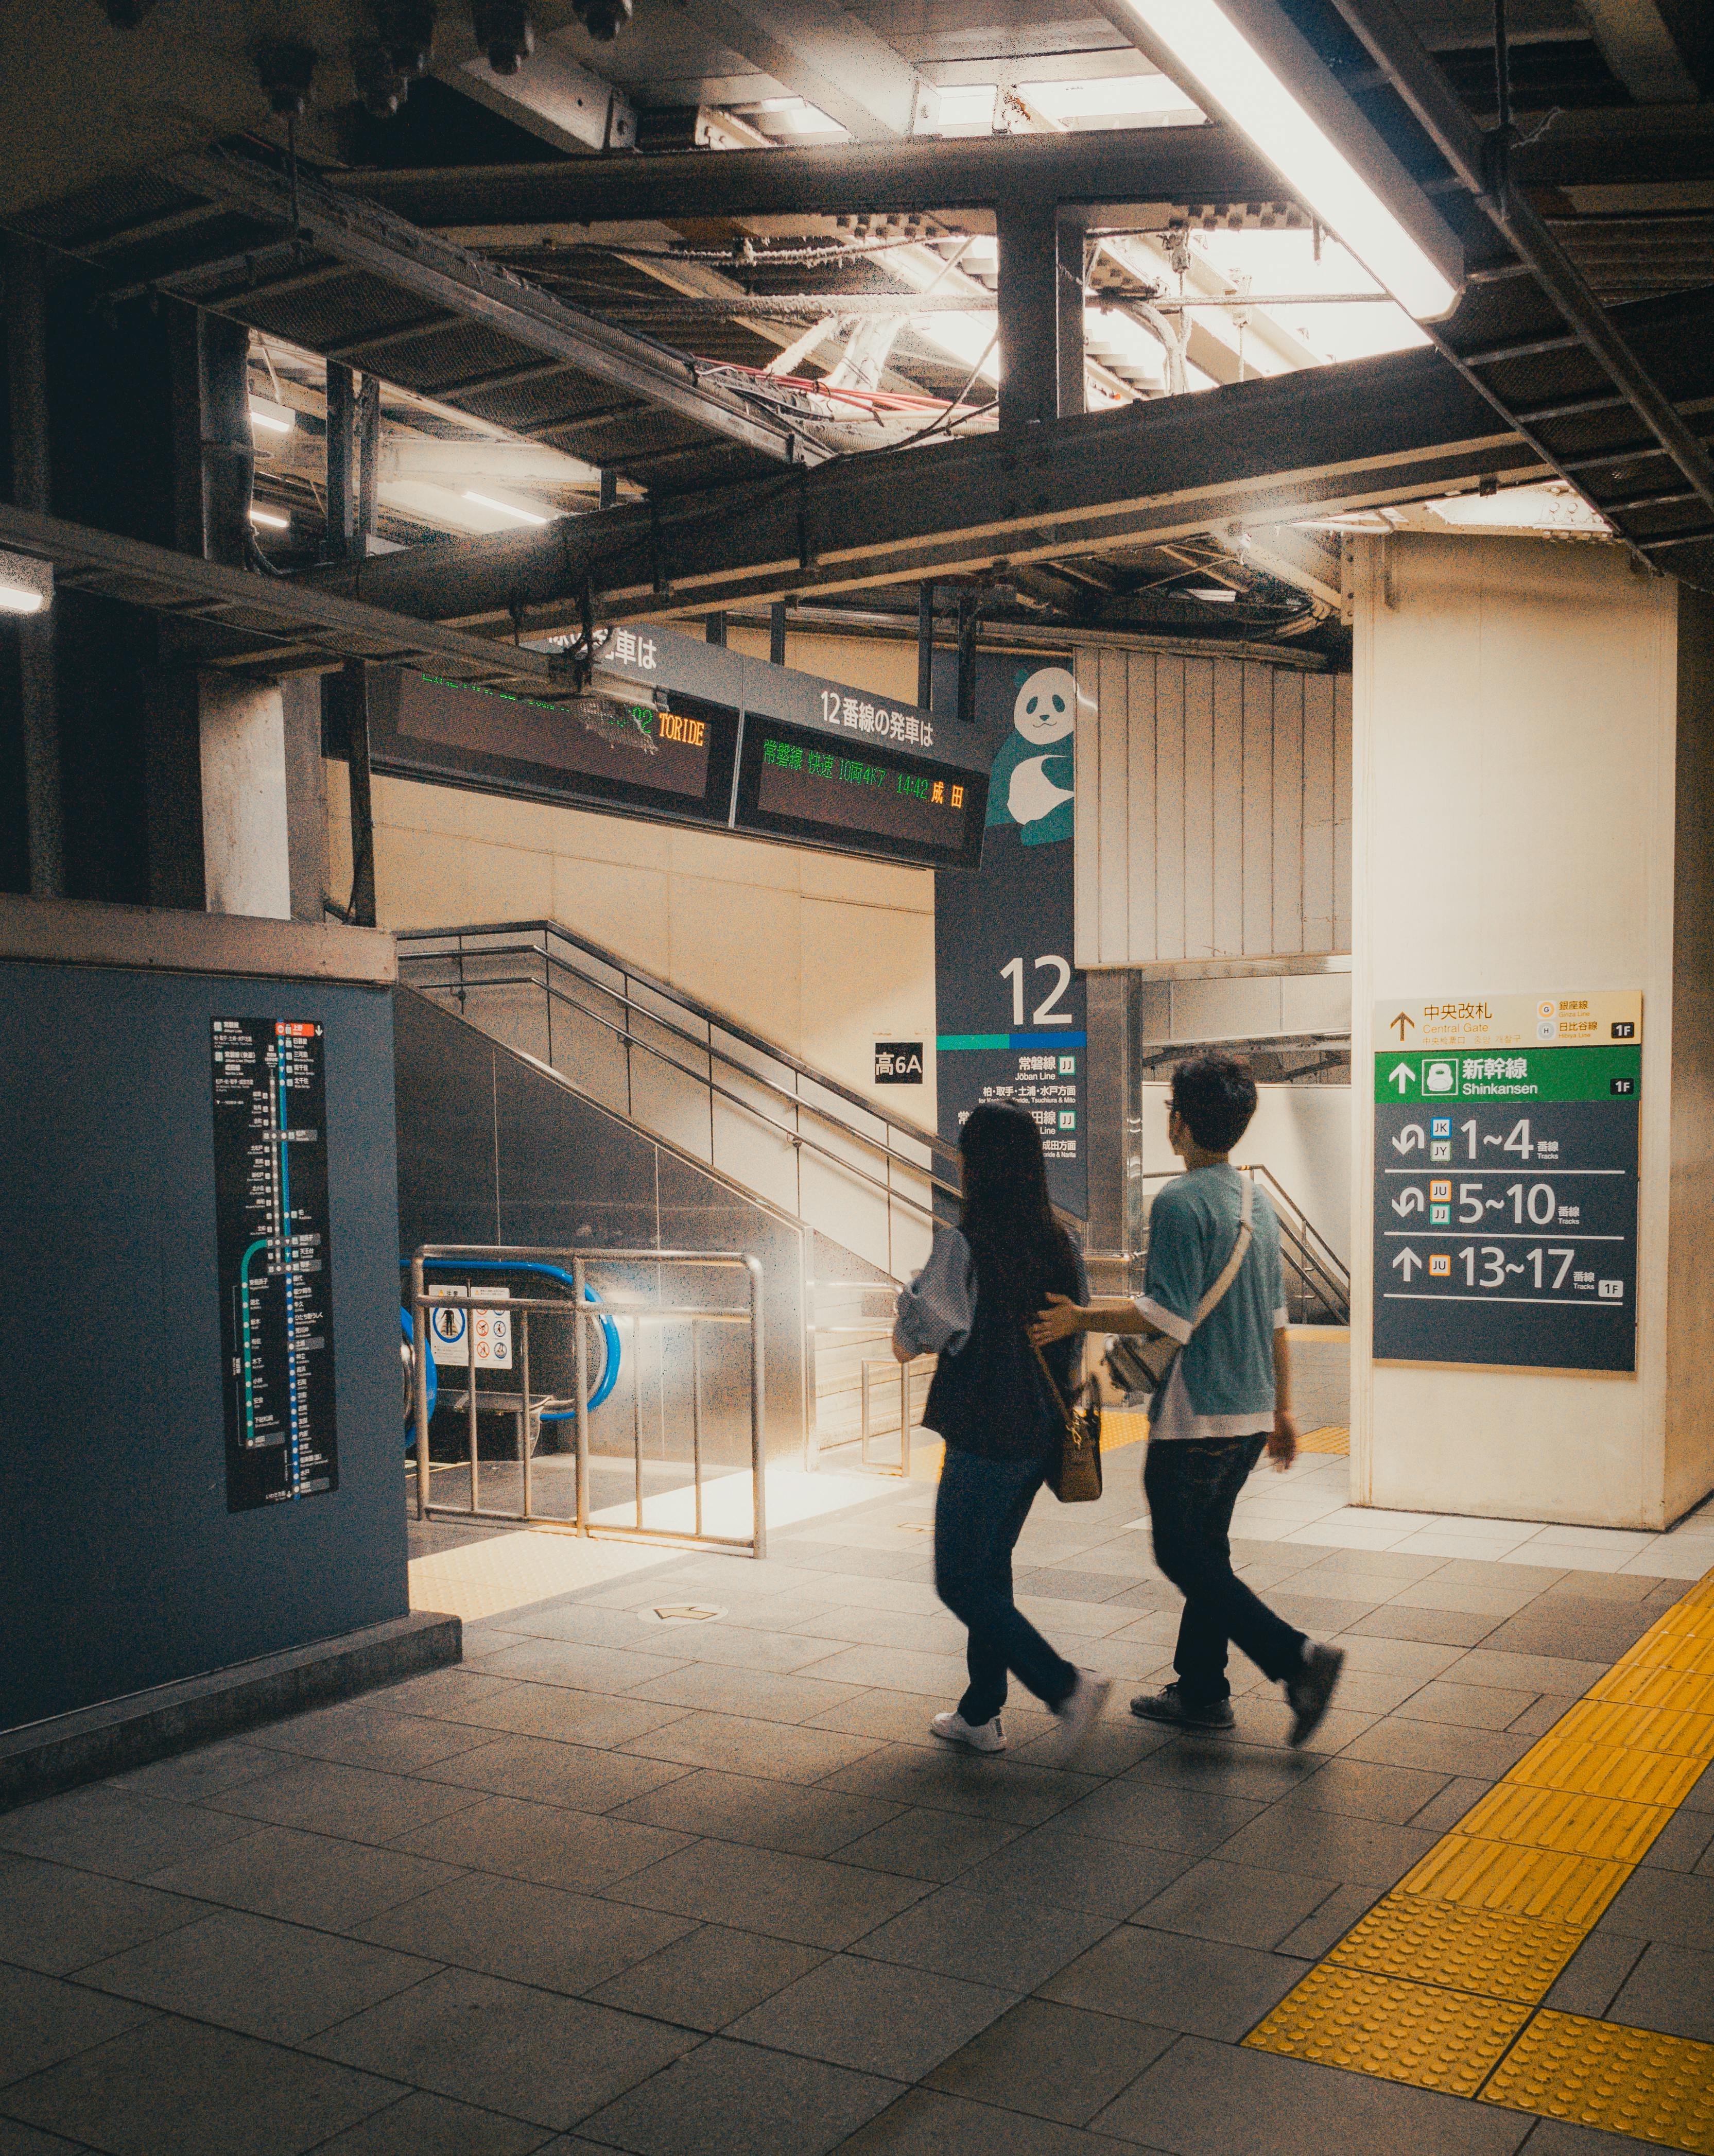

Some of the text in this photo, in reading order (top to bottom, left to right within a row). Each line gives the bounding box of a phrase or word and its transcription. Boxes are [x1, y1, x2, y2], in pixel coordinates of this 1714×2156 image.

[821, 690, 933, 747] 12番線の発車は
[659, 712, 705, 747] TORIDE
[897, 773, 929, 799] 14:42
[931, 780, 964, 809] 成田
[1000, 955, 1072, 1025] 12
[1559, 1001, 1588, 1010] 銀座線
[1424, 1002, 1492, 1021] 中央改札
[1423, 1023, 1489, 1034] Central Gate
[1559, 1021, 1598, 1031] 日比谷線
[1615, 1025, 1631, 1037] 1F
[875, 1052, 923, 1076] 高6A
[1018, 1056, 1071, 1071] 常磐線 JJ
[1462, 1058, 1528, 1080] 新幹線
[1039, 1072, 1055, 1080] Line
[1462, 1083, 1538, 1095] Shinkansen
[1615, 1081, 1630, 1092] 1F
[1062, 1115, 1071, 1125] JJ
[1040, 1127, 1055, 1135] Line
[1434, 1123, 1447, 1133] JK
[1434, 1146, 1447, 1157] JY
[1537, 1141, 1559, 1152] 番線
[1434, 1185, 1447, 1196] JU
[1434, 1209, 1446, 1219] JJ
[1558, 1206, 1580, 1218] 番線
[1433, 1261, 1446, 1271] JU
[1573, 1271, 1595, 1283] 番線
[1604, 1284, 1619, 1295] 1F
